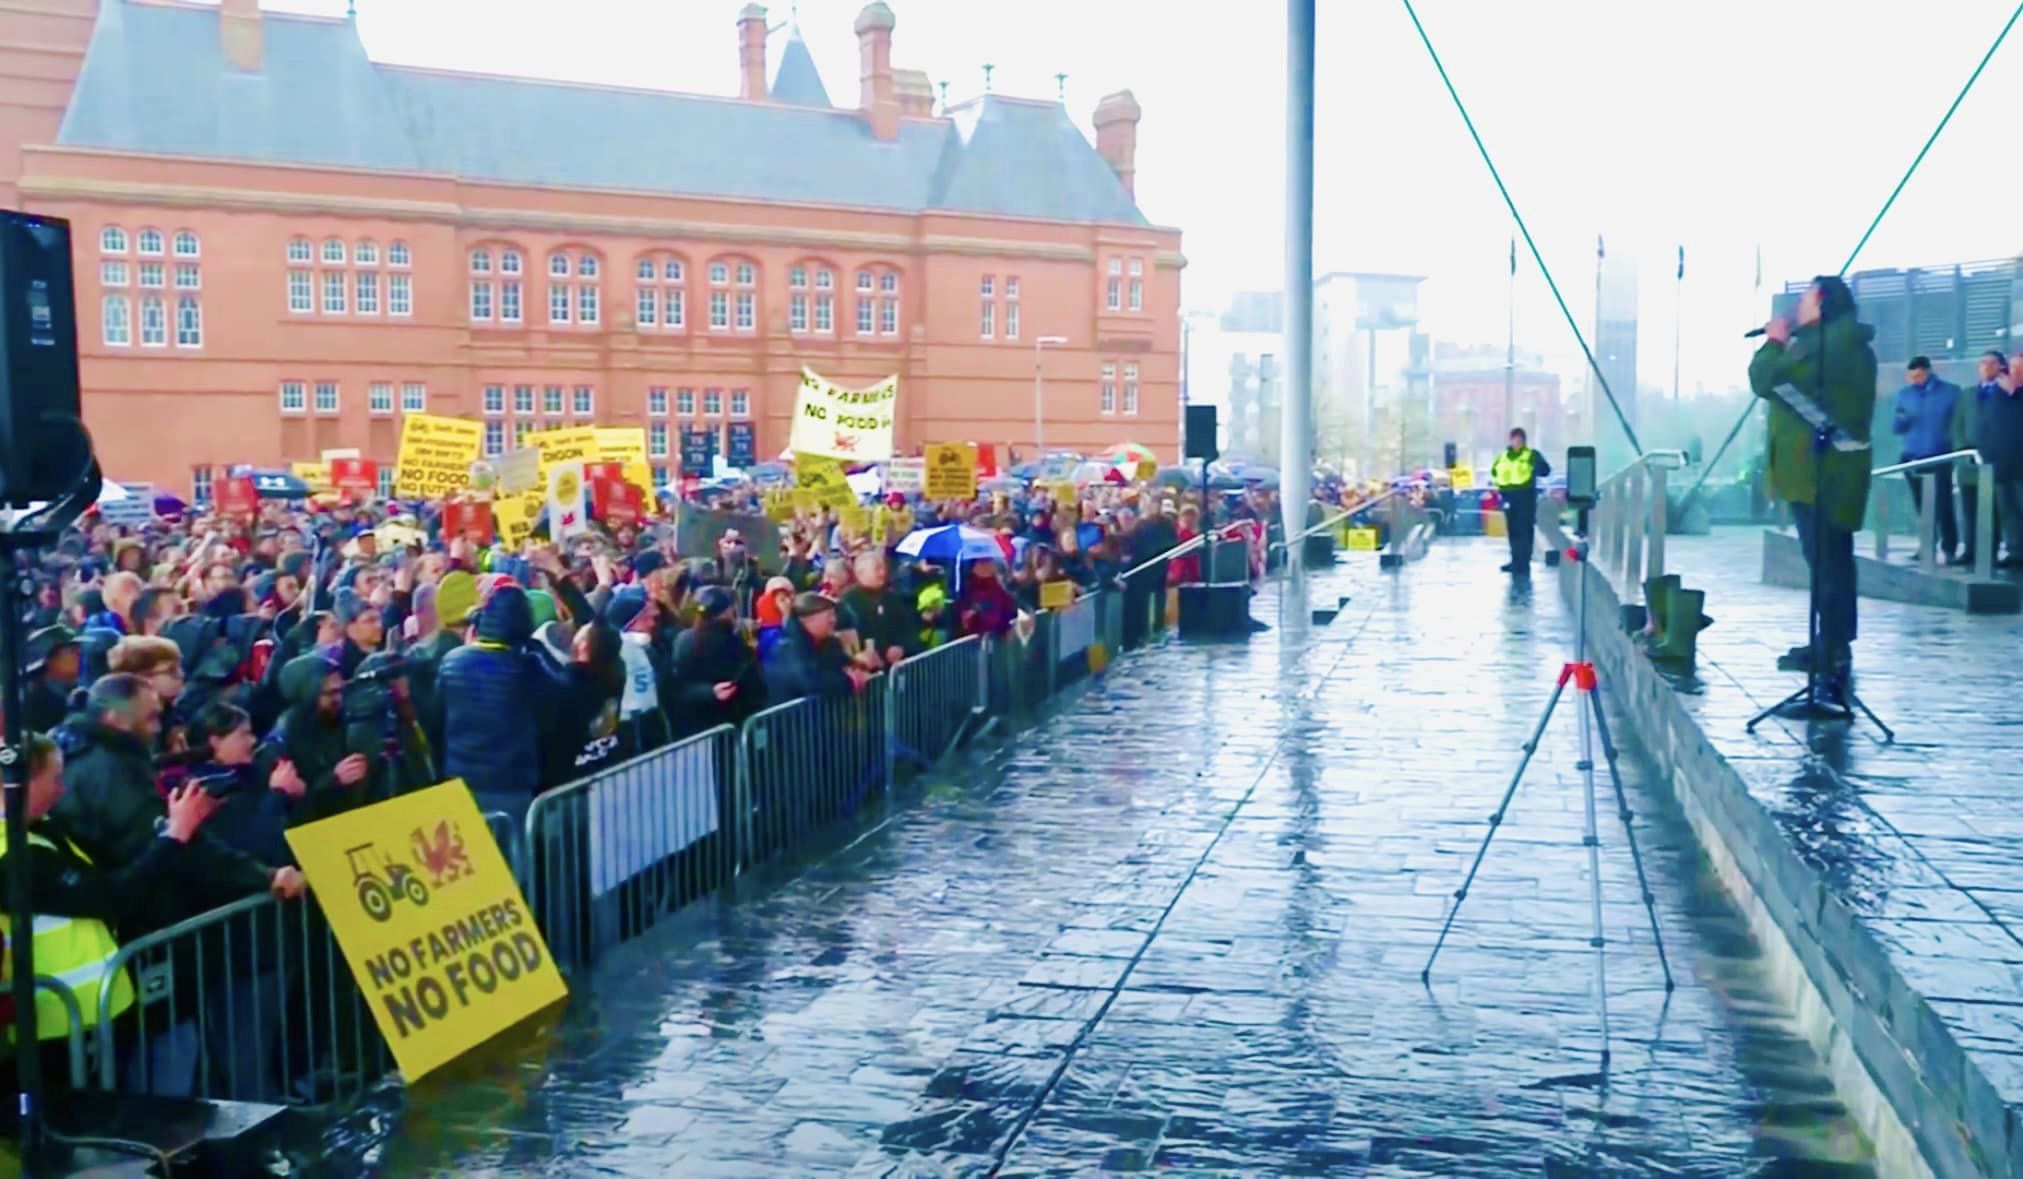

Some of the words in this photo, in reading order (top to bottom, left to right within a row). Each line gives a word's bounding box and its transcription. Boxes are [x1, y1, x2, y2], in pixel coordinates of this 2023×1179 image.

[804, 403, 826, 420] NO
[837, 414, 878, 430] FOOD
[401, 468, 424, 481] NO
[427, 470, 469, 486] FOOD
[365, 948, 411, 989] NO
[409, 898, 522, 969] FARMERS
[382, 976, 449, 1038] NO
[445, 931, 541, 1006] FOOD
